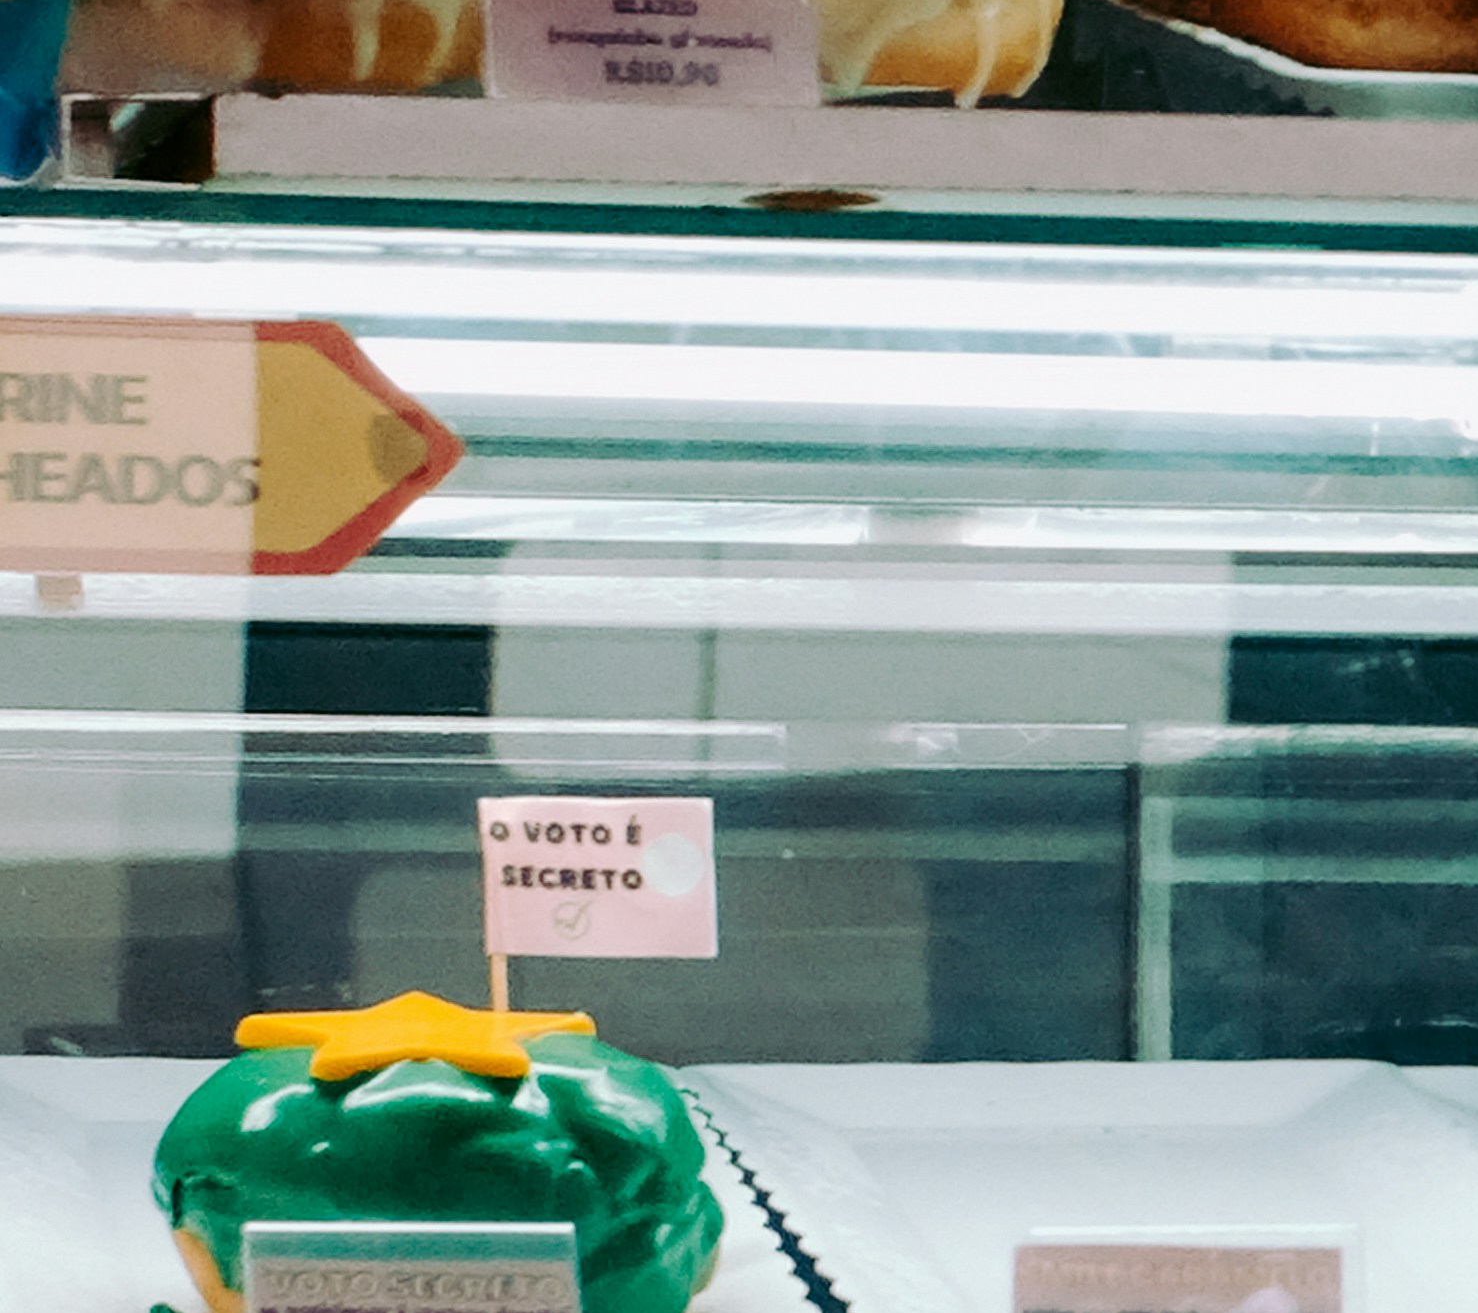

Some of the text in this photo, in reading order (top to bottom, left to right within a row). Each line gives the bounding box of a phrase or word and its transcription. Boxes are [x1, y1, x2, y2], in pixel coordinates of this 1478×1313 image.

[489, 821, 510, 842] O
[523, 822, 613, 845] VOTO
[501, 864, 644, 891] SECRETO
